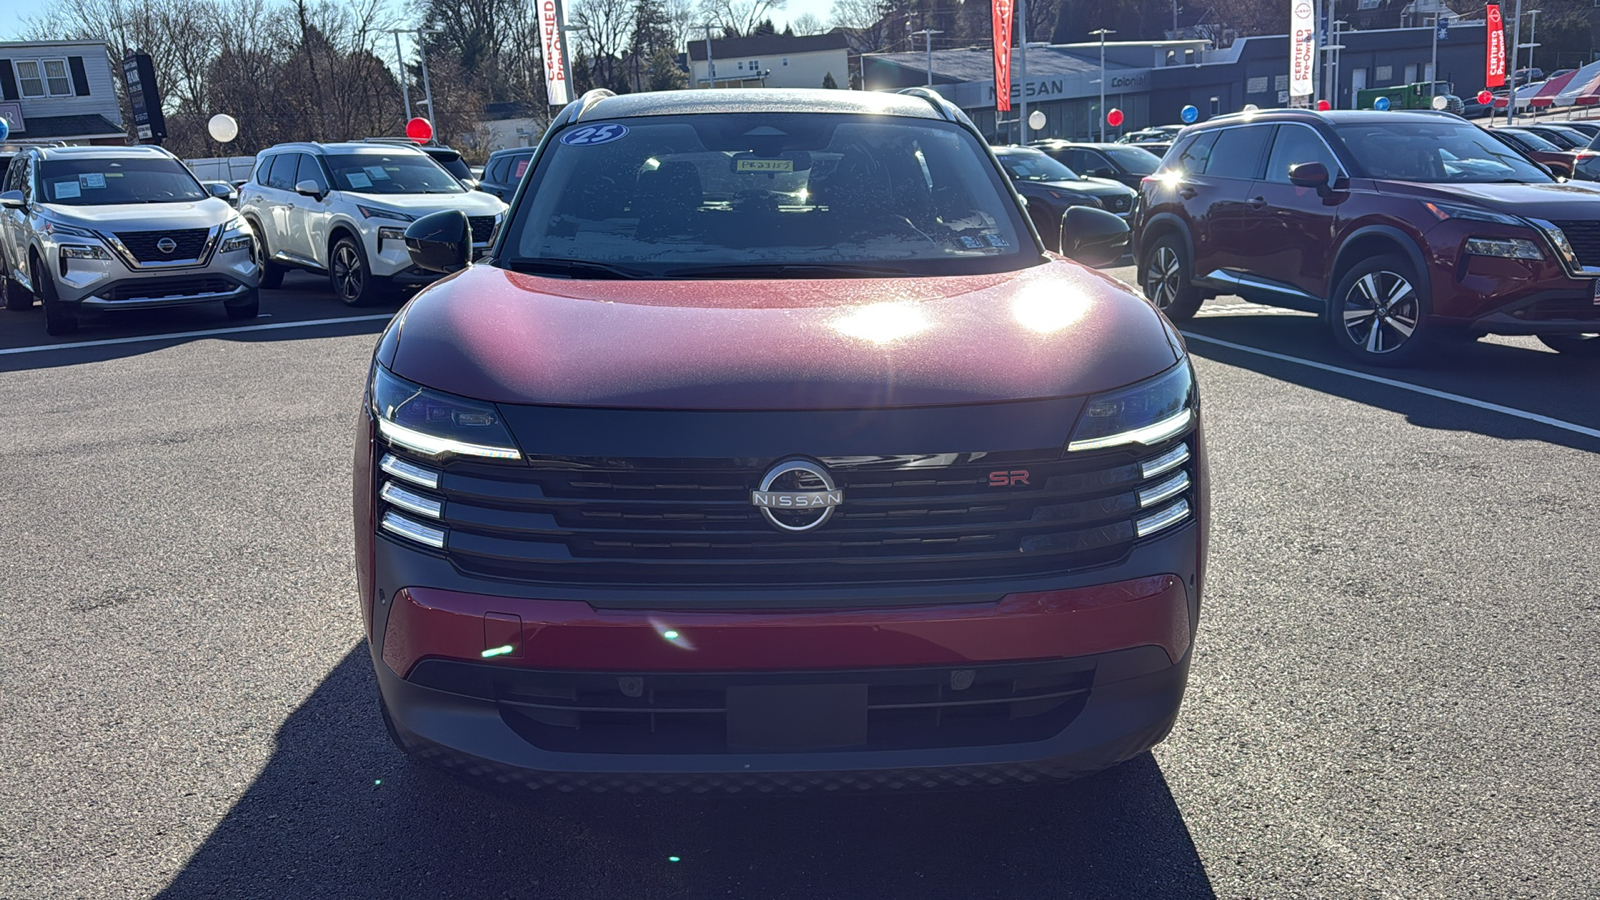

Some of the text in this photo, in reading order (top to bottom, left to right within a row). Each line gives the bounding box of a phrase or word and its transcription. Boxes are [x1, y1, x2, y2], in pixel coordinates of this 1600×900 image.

[1294, 29, 1304, 81] CERTIFIED
[1302, 29, 1312, 81] Pre-Owned
[1489, 30, 1499, 76] CERTIFIED
[1497, 29, 1505, 75] Pre-Owned
[988, 79, 1063, 100] NSSAN
[569, 125, 618, 144] 25
[989, 470, 1030, 486] SR
[754, 492, 841, 506] NISSAN
